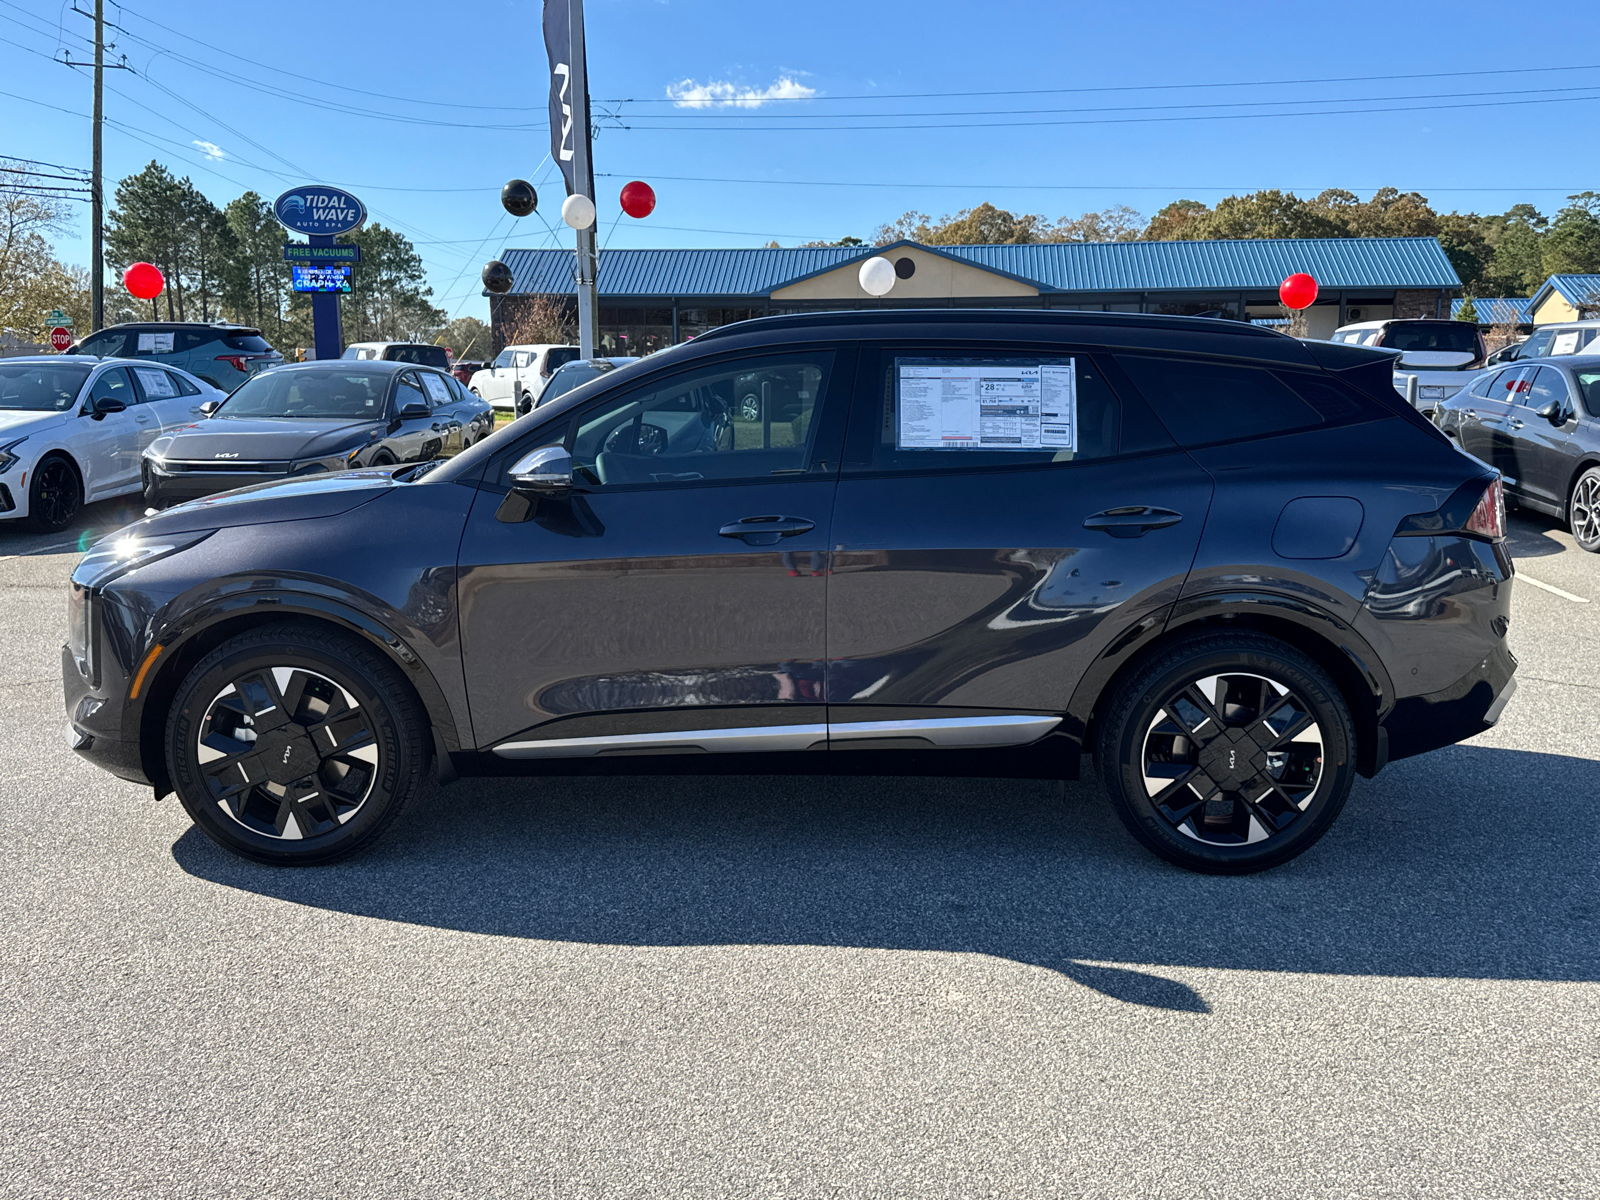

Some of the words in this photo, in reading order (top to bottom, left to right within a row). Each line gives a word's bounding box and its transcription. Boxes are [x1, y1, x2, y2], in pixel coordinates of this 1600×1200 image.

[305, 195, 347, 208] TIDAL
[313, 208, 356, 221] WAVE
[287, 248, 310, 257] FREE
[312, 248, 354, 257] VACUUMS
[52, 334, 70, 345] STOP
[985, 383, 995, 391] 28
[1269, 660, 1327, 703] MICHELIN
[186, 677, 209, 710] PRIMACY
[1327, 709, 1345, 743] PRIMACY
[177, 717, 191, 783] MICHELIN
[282, 745, 292, 764] KIA
[382, 726, 397, 791] MICHELIN
